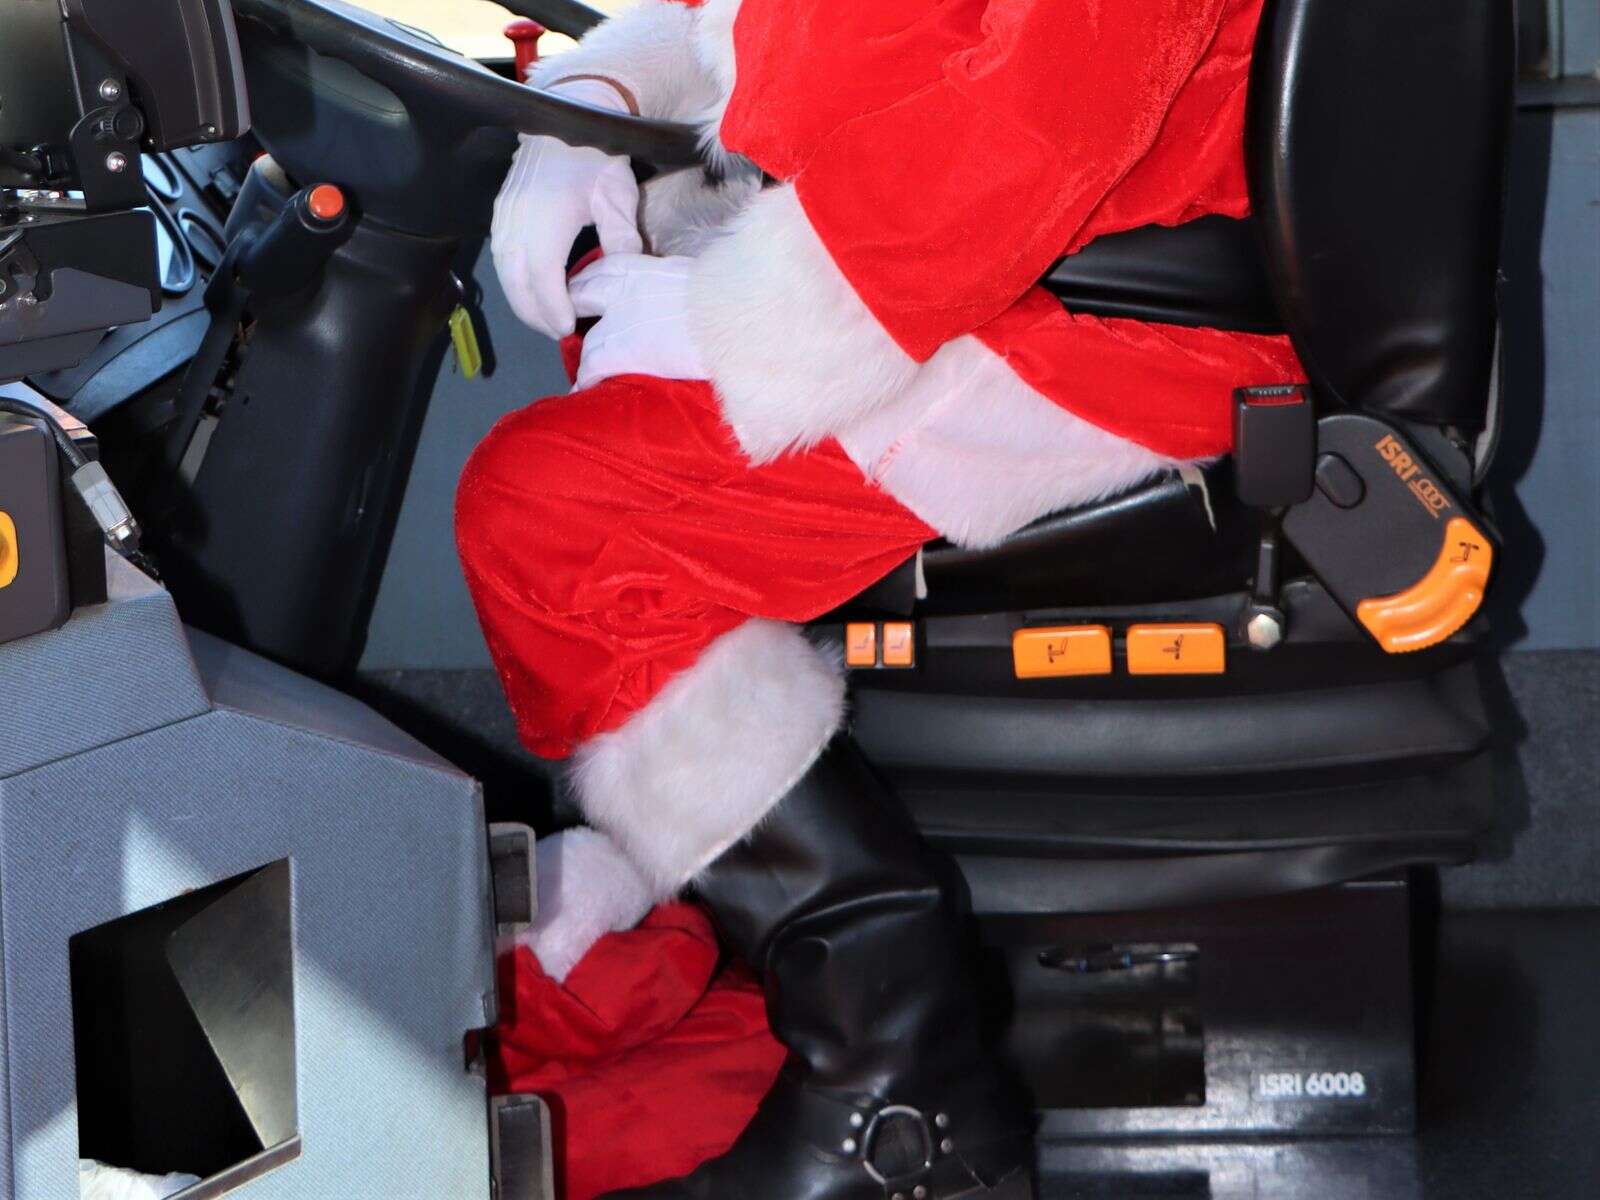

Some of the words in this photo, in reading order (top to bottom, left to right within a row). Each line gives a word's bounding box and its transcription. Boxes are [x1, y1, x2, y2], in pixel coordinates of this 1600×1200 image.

[1375, 433, 1419, 481] ISRI
[1260, 1073, 1301, 1095] ISRI
[1305, 1071, 1365, 1095] 6008
